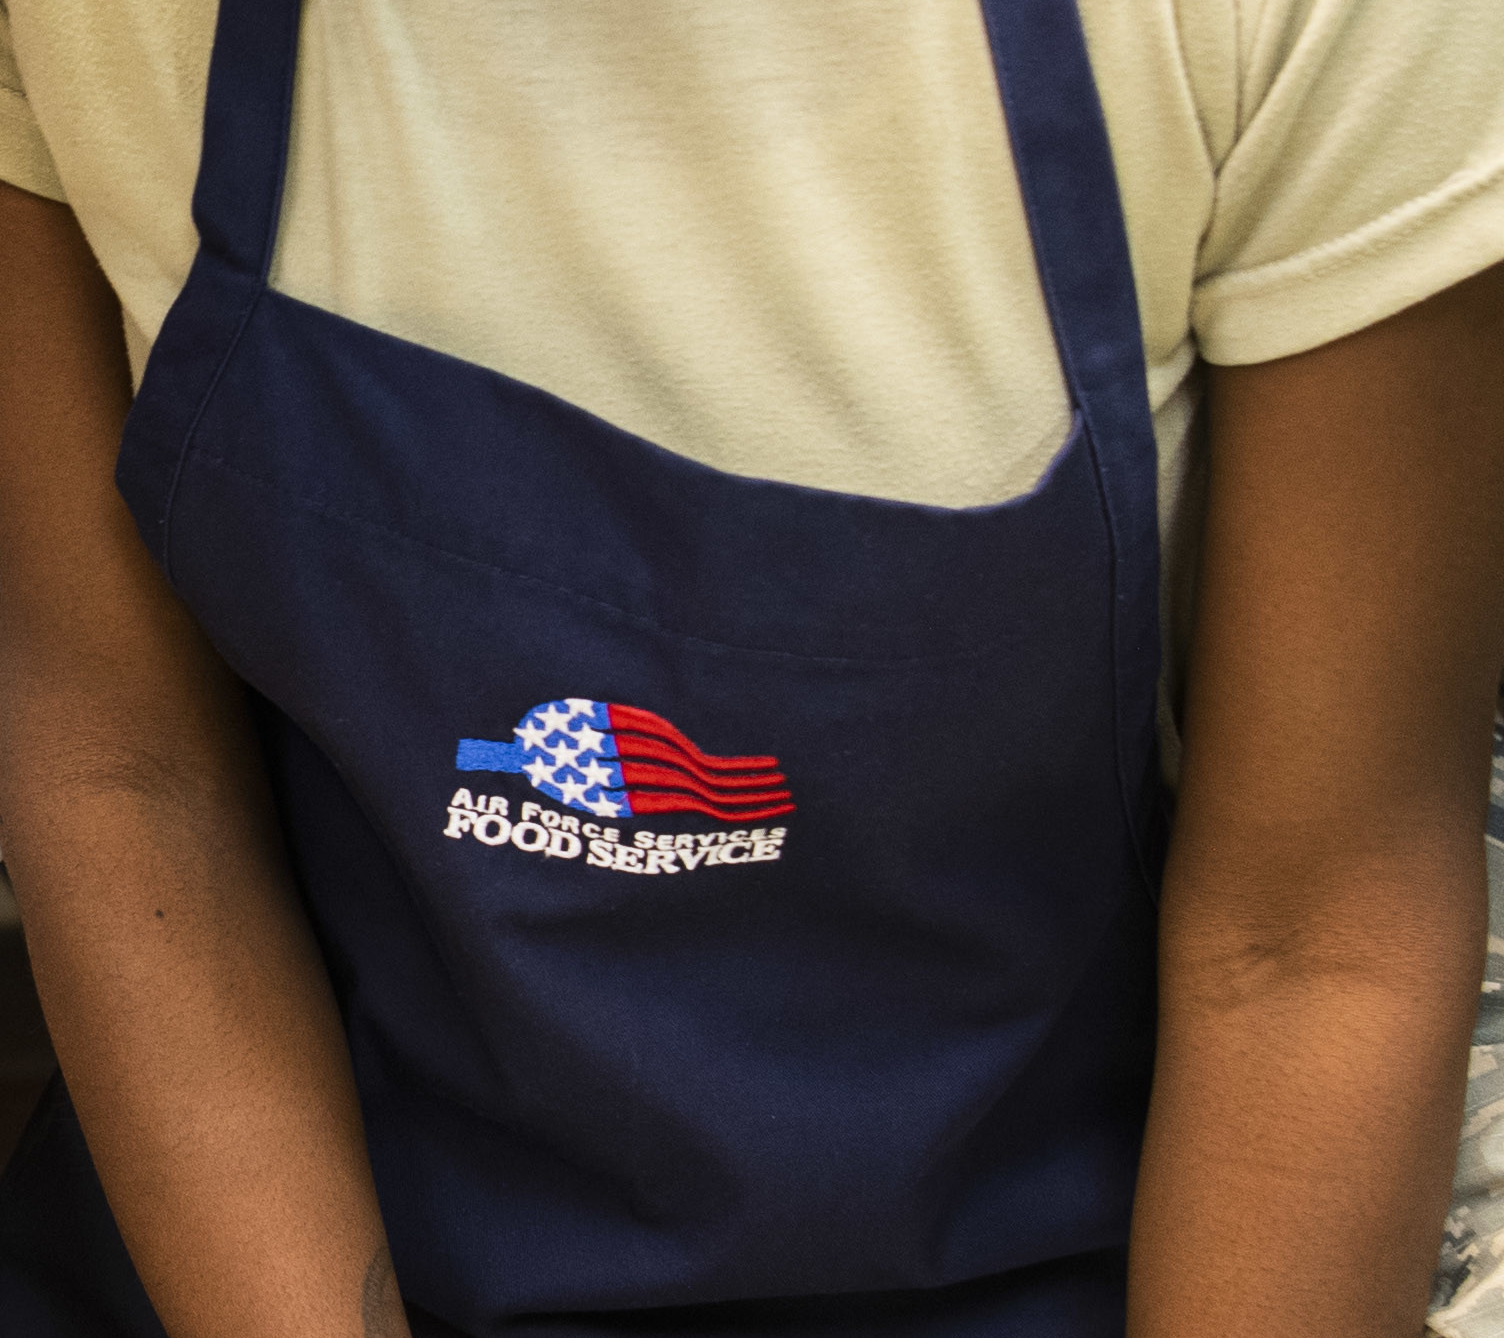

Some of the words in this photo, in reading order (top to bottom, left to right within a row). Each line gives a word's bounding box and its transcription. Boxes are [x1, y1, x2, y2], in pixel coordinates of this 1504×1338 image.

[443, 807, 582, 859] FOOD
[587, 837, 784, 875] SERVICE
[451, 788, 509, 816] AIR
[521, 802, 621, 843] FORCE
[634, 827, 788, 851] SERVICES
